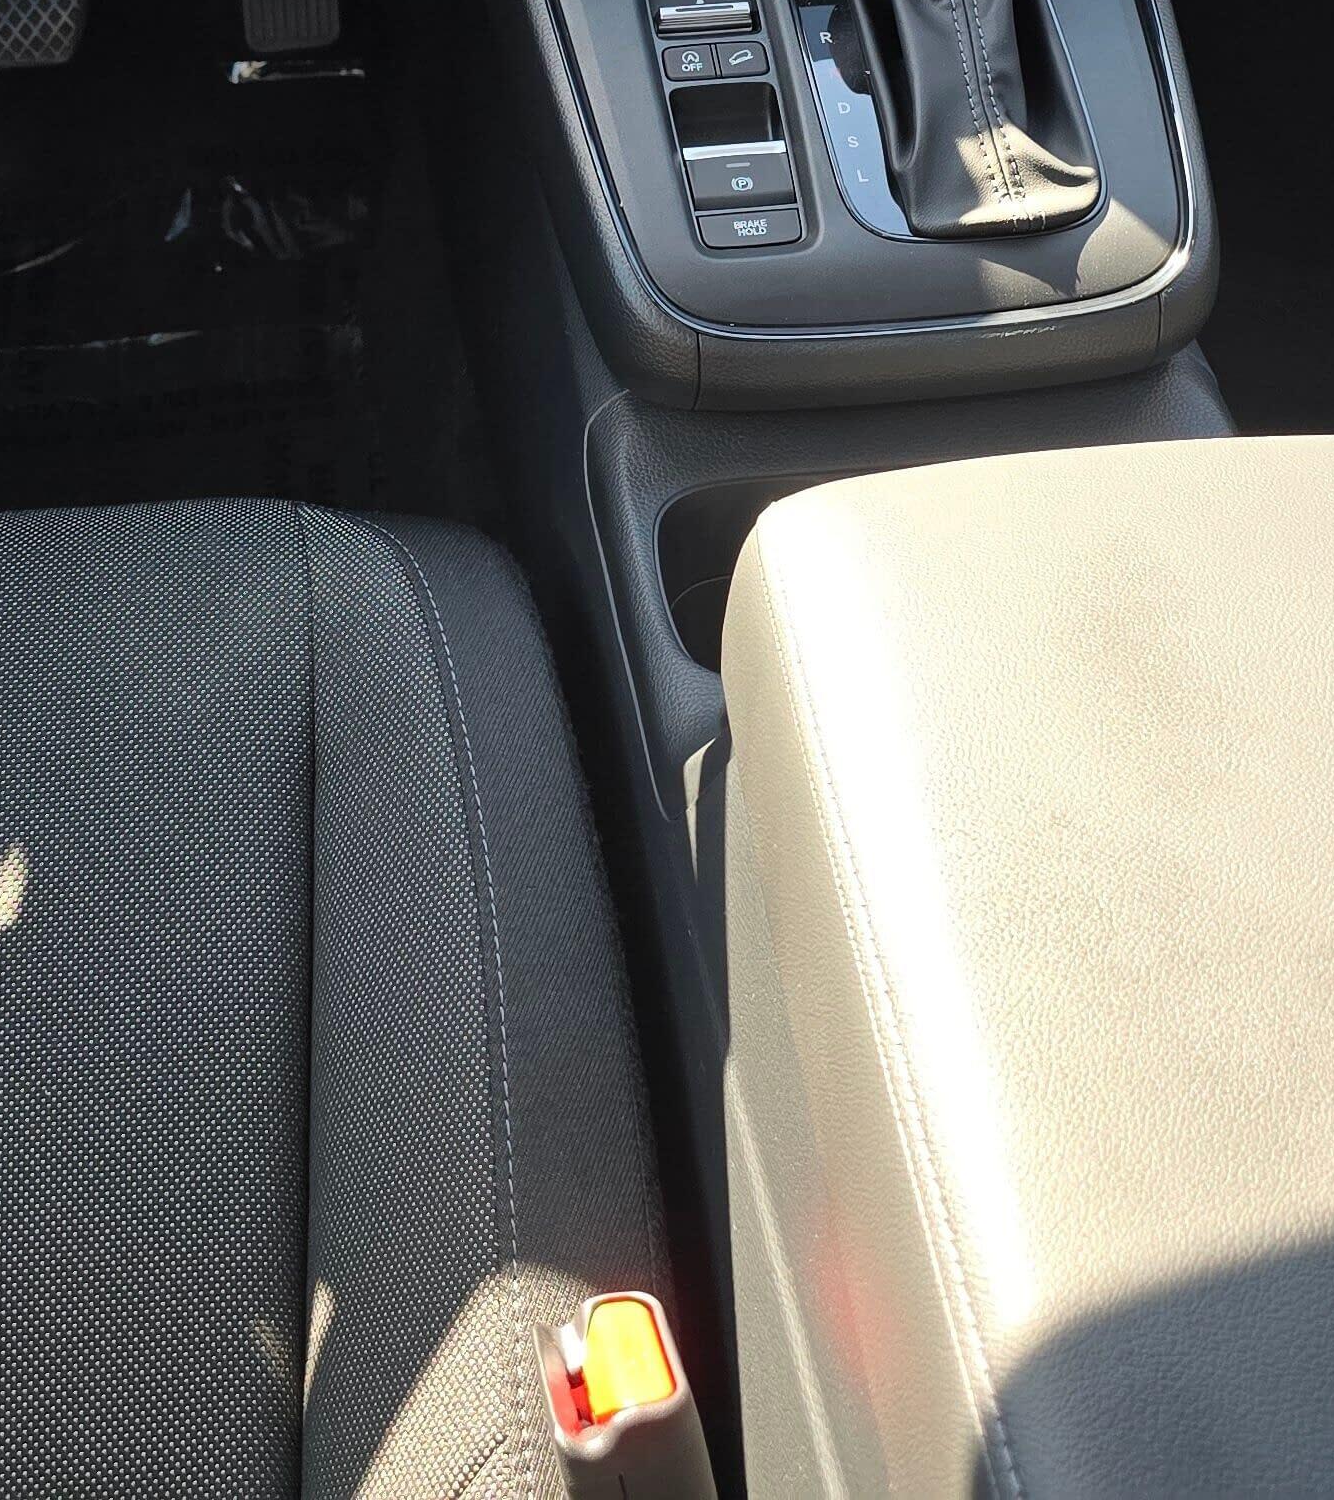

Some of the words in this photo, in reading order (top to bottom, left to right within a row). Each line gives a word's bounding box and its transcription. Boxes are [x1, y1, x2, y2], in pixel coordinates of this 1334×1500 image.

[819, 32, 833, 44] R
[681, 62, 703, 72] OFF
[837, 102, 851, 114] D
[847, 136, 859, 148] S
[857, 170, 869, 182] L
[733, 218, 768, 230] BRAKE
[737, 226, 767, 237] HOLD
